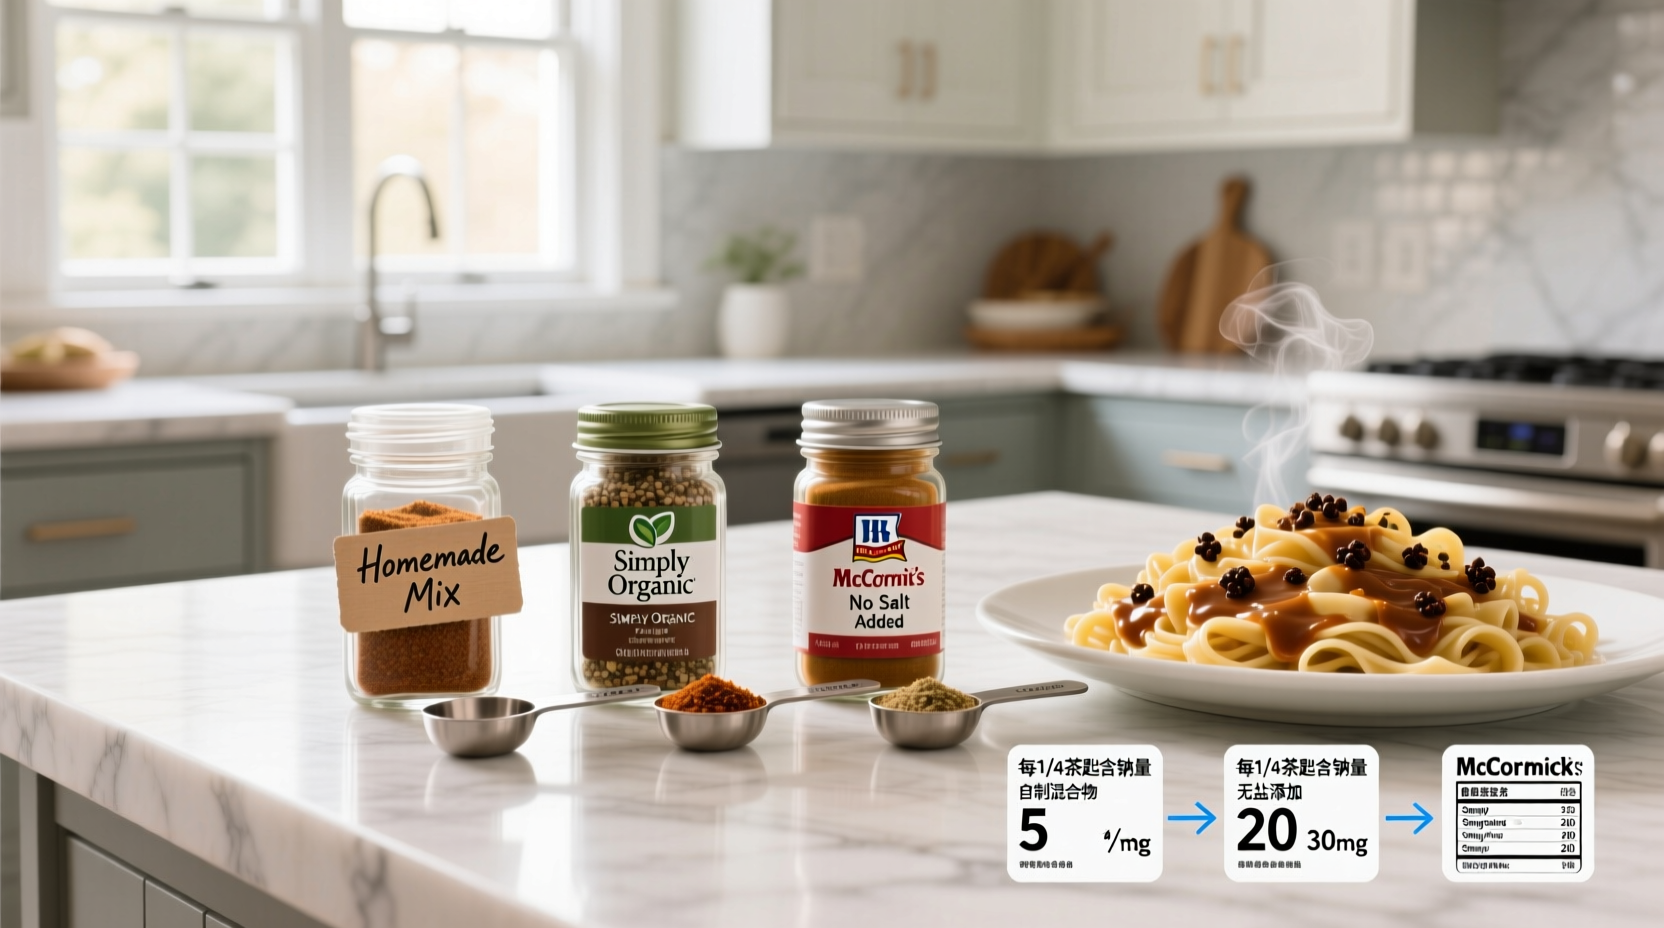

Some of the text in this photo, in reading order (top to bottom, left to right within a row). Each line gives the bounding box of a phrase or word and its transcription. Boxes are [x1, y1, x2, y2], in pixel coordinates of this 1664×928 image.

[357, 532, 505, 584] Homemade
[614, 549, 690, 578] Simply
[404, 577, 460, 613] Mix
[608, 574, 694, 602] Organic
[850, 593, 910, 611] No Salt
[854, 614, 904, 629] Added
